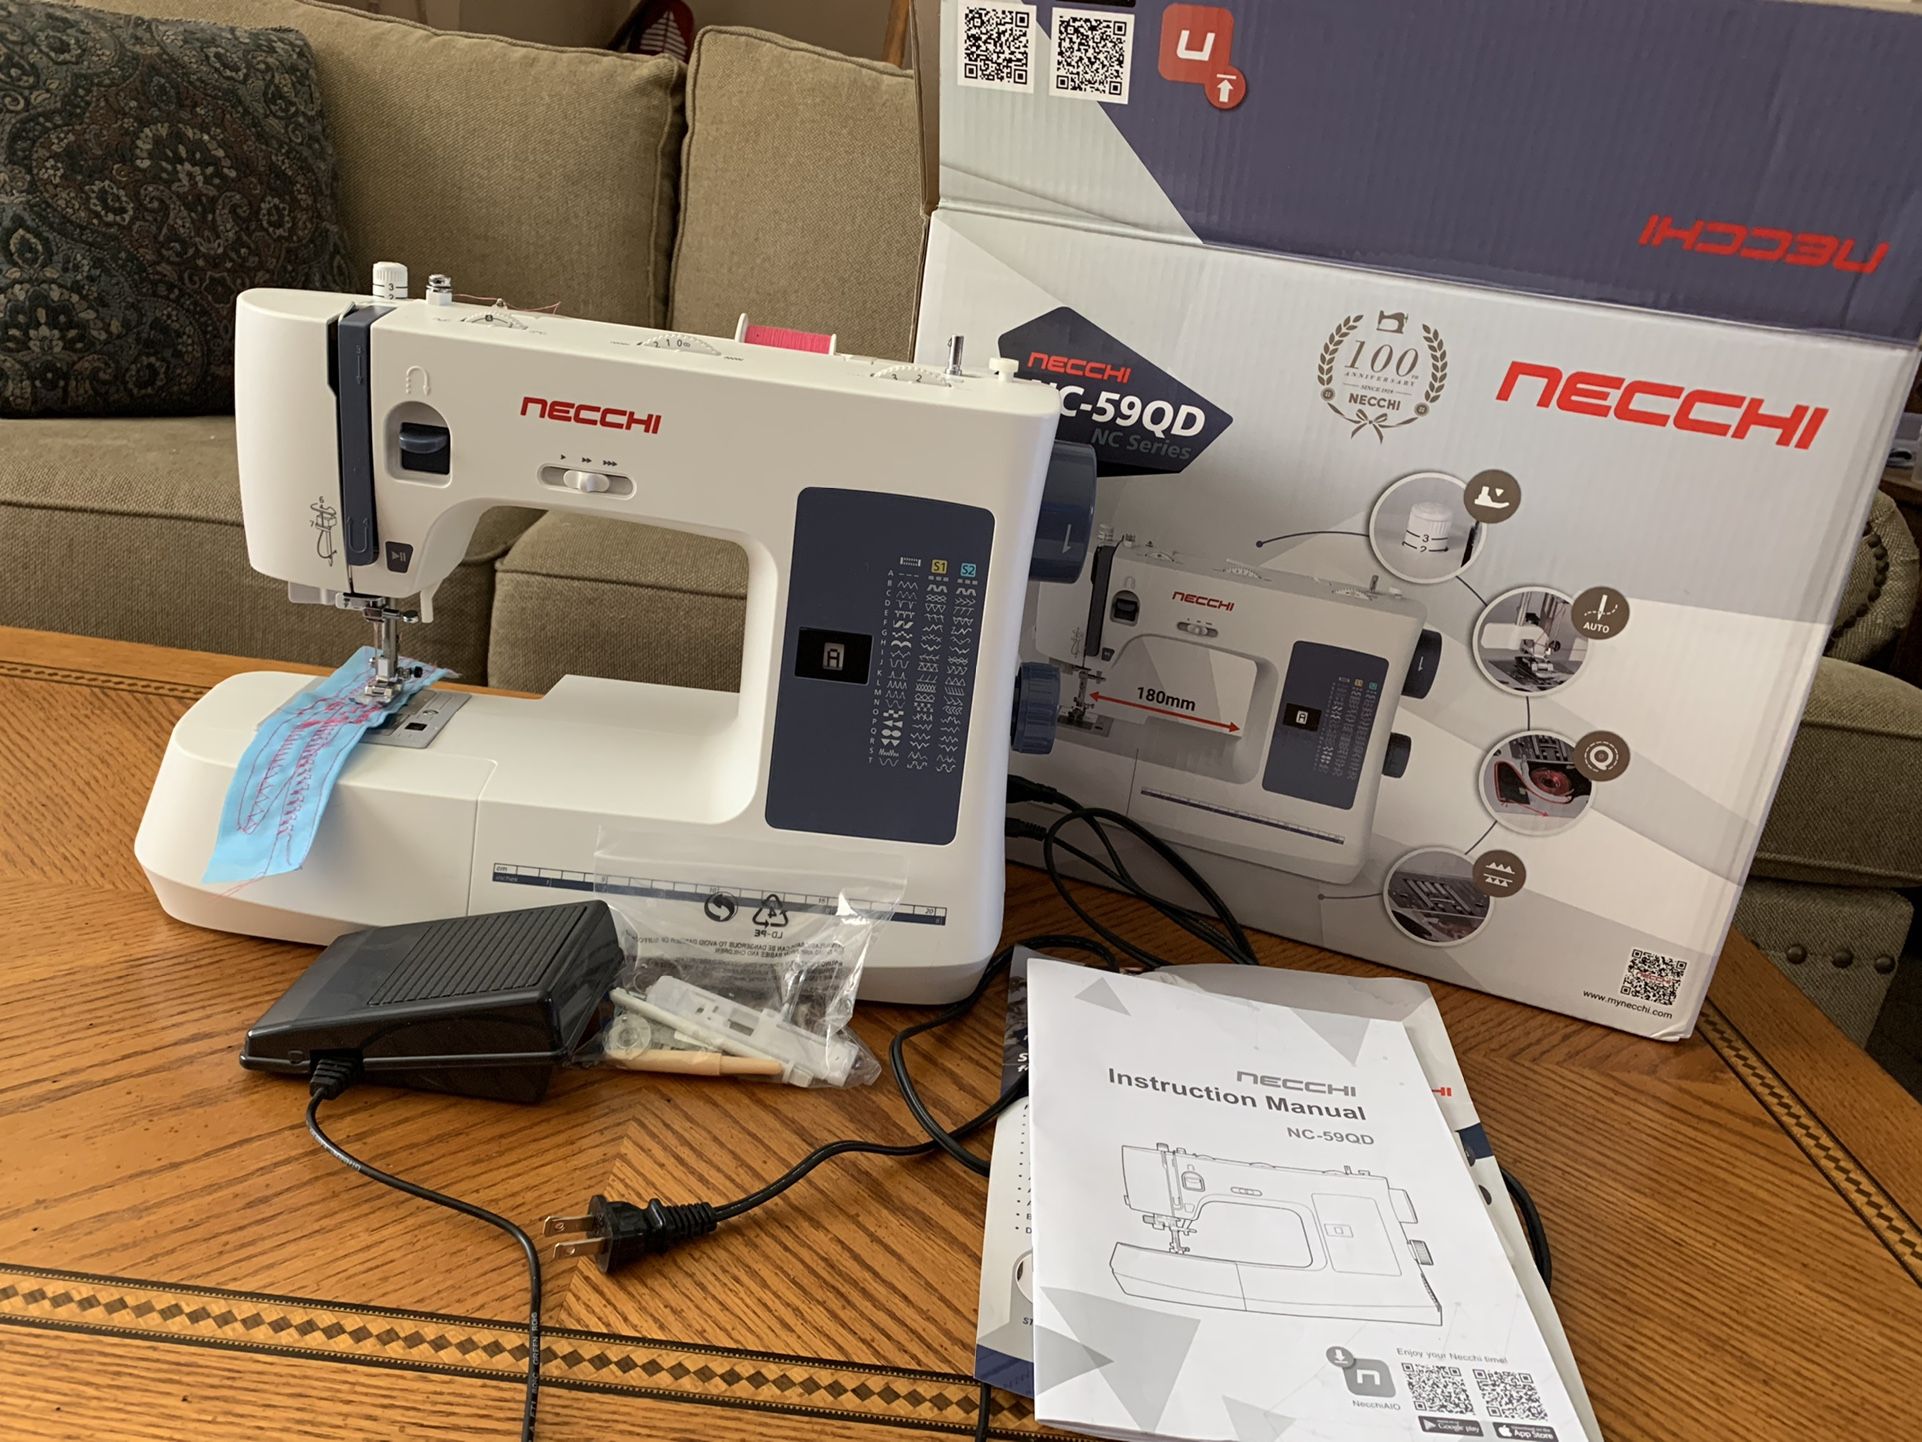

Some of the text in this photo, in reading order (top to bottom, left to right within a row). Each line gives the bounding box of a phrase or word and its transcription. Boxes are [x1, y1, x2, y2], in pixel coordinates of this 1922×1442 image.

[1637, 213, 1891, 275] NECCHI
[1027, 352, 1132, 384] NECCHI
[1344, 340, 1419, 377] 100
[916, 374, 923, 382] 2
[1361, 384, 1379, 392] SINCE
[1031, 379, 1205, 438] C-59QD
[1348, 393, 1401, 411] NECCHI
[1495, 360, 1830, 450] NECCHI
[520, 396, 662, 434] NECCHI
[1090, 428, 1192, 460] NC Series
[1422, 534, 1430, 543] 3
[933, 561, 946, 572] S1
[962, 564, 975, 576] S2
[1172, 591, 1235, 611] NECCHI
[1583, 621, 1610, 634] AUTO
[827, 648, 840, 668] A
[1137, 686, 1196, 711] 180mm
[1583, 990, 1672, 1019] www.mynecchi.com
[1237, 1070, 1356, 1097] NECCHI
[1108, 1068, 1366, 1120] Instruction Manual
[1287, 1127, 1374, 1145] NC-59QD
[1396, 1347, 1423, 1357] Enjoy
[1426, 1351, 1446, 1359] your
[1449, 1353, 1483, 1362] Necchi
[1438, 1423, 1479, 1433] Google play
[1514, 1429, 1554, 1440] App Store
